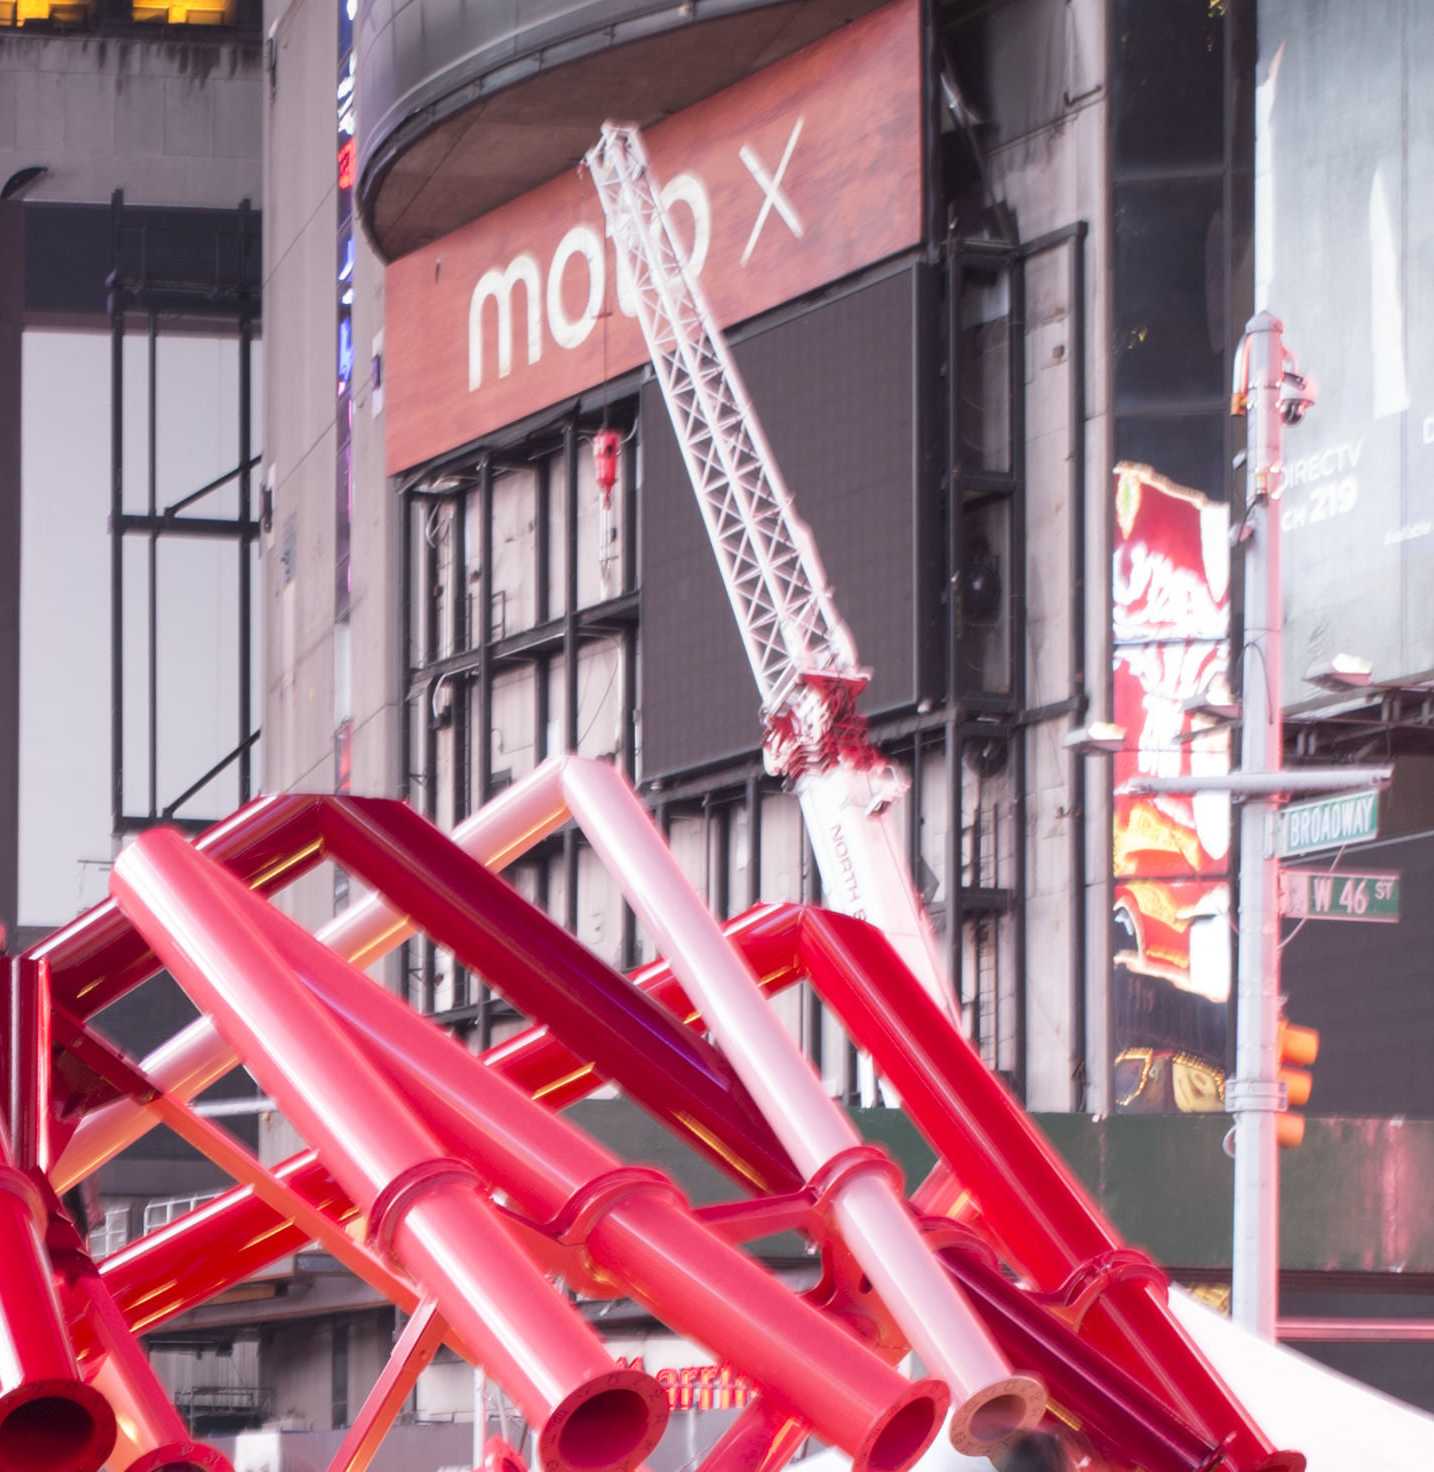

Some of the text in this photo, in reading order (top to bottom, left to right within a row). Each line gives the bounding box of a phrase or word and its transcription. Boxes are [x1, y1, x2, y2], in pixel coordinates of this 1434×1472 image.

[1280, 474, 1359, 533] CH 219
[1290, 795, 1375, 848] BROADWAY
[1313, 877, 1396, 915] W 46 ST
